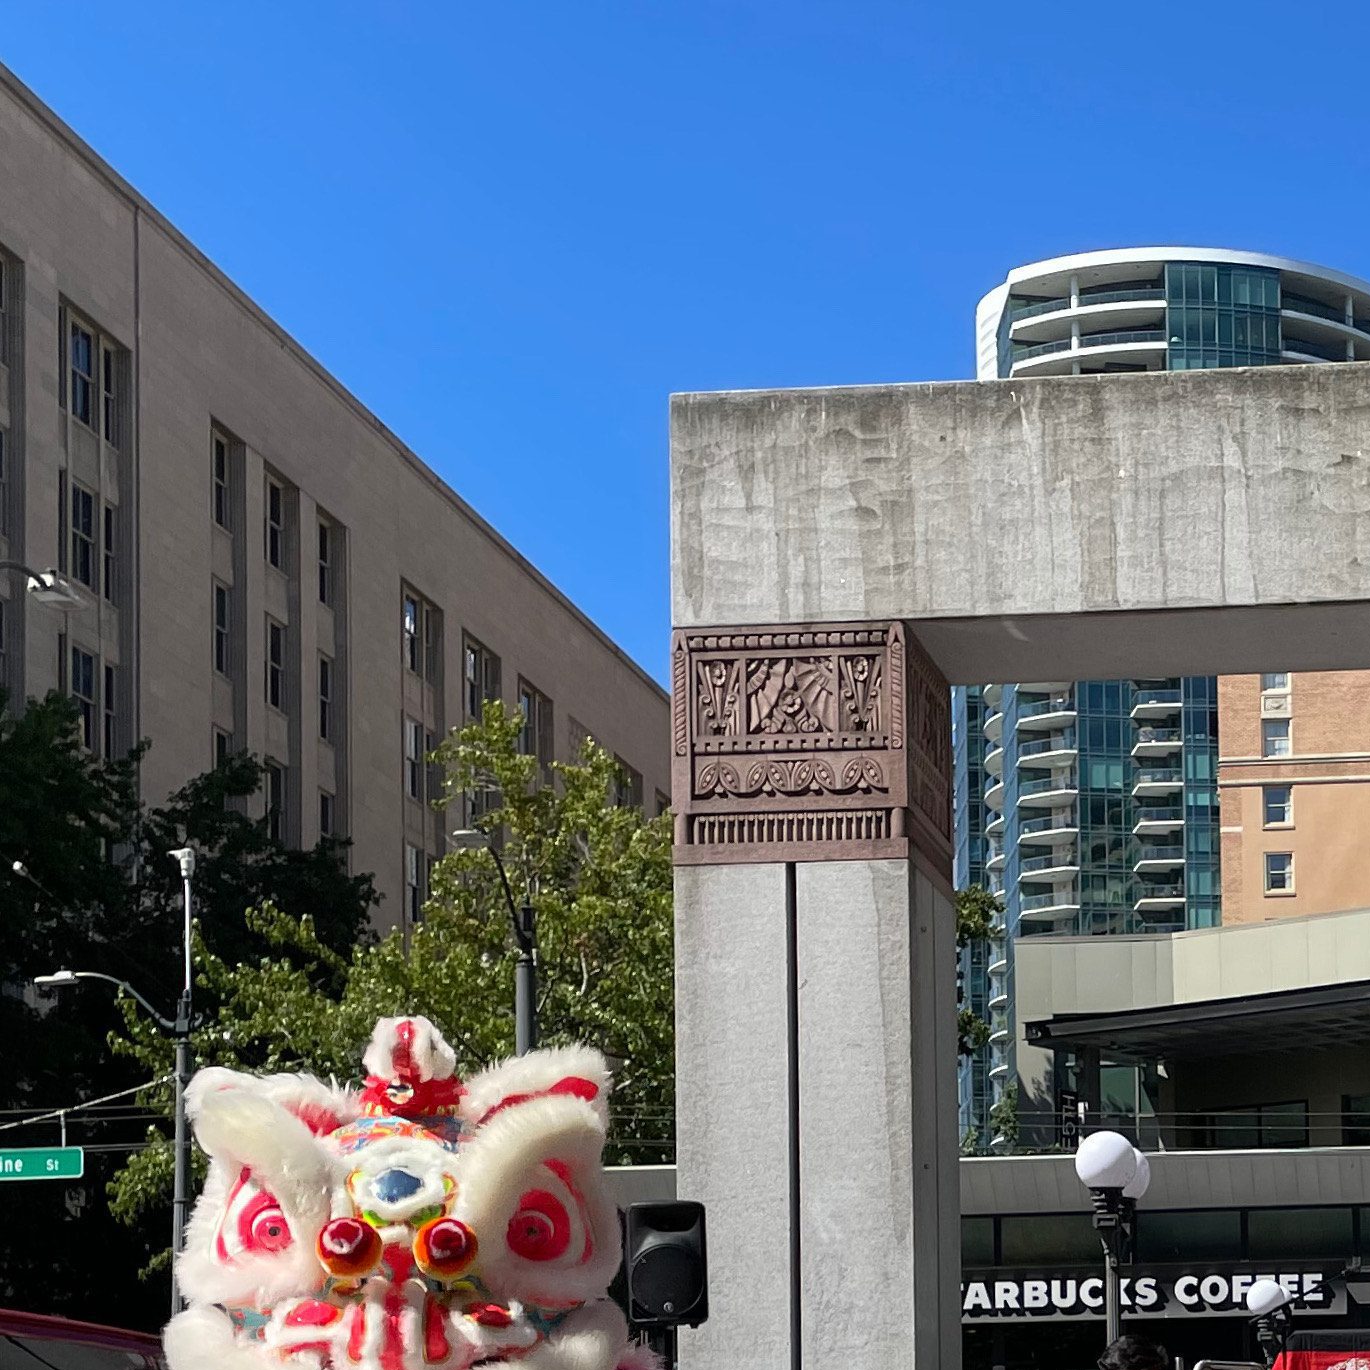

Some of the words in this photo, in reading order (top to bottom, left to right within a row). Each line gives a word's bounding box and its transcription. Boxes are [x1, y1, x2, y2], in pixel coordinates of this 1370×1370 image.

[46, 1158, 59, 1171] St
[961, 1278, 1157, 1310] ARBUCKS
[1174, 1273, 1323, 1305] COFEE
